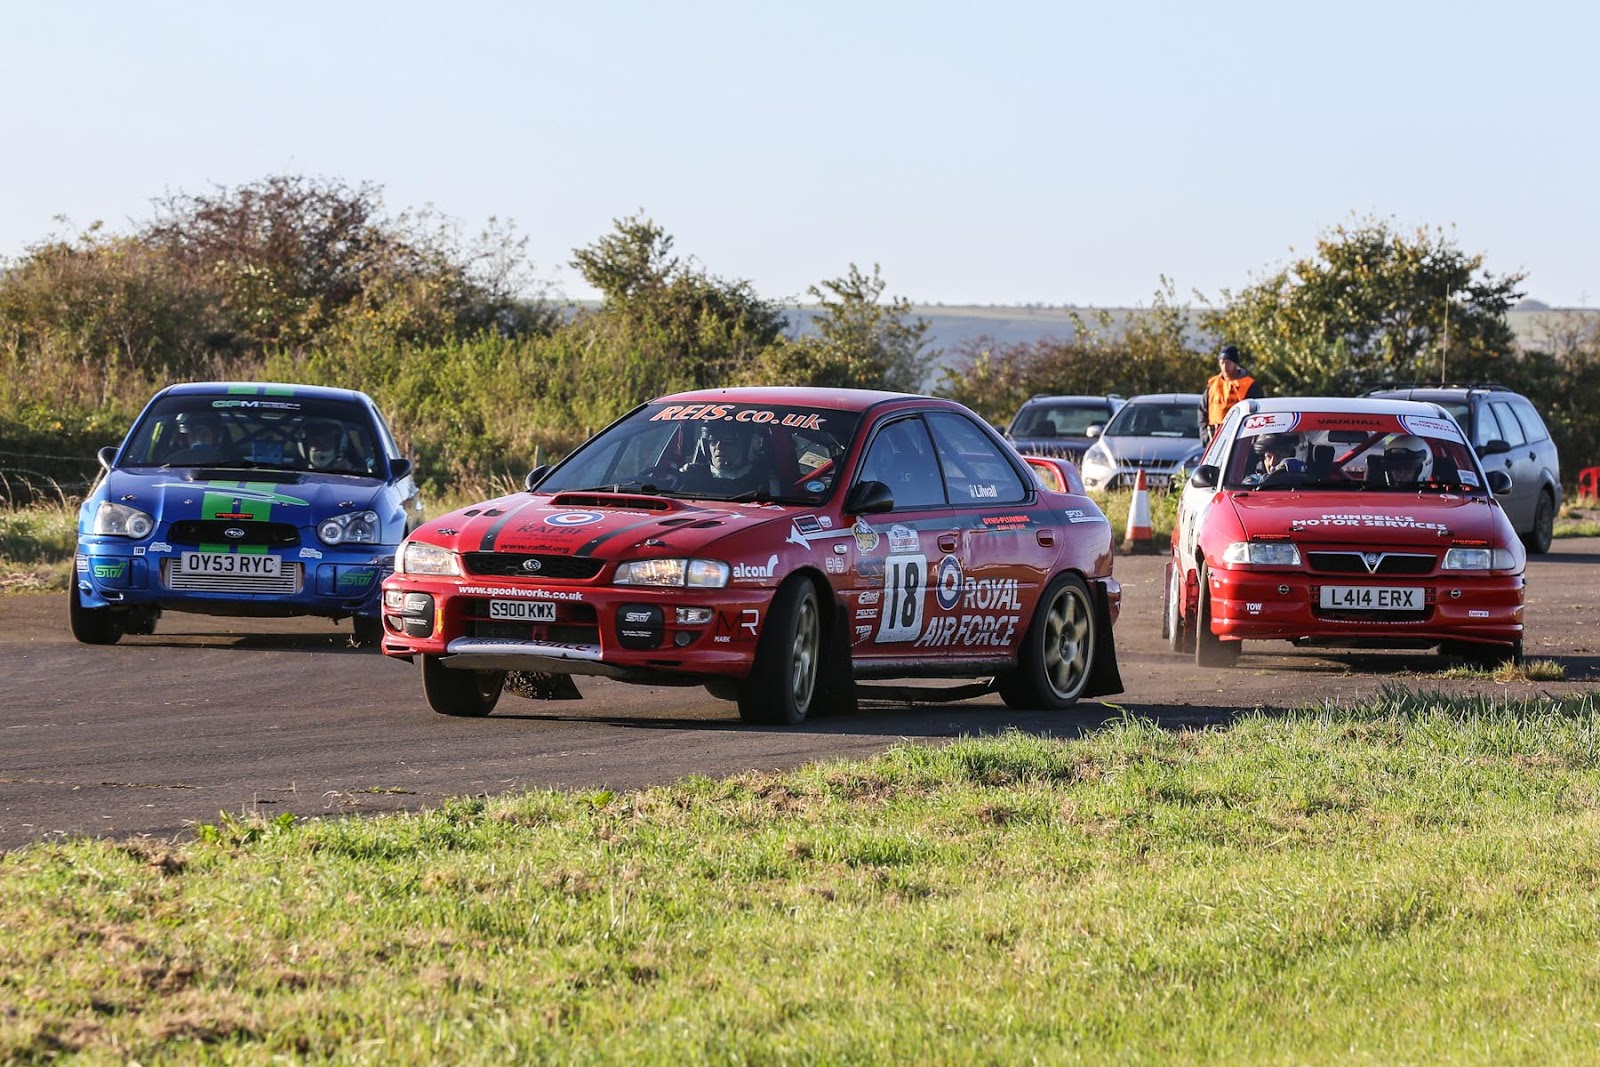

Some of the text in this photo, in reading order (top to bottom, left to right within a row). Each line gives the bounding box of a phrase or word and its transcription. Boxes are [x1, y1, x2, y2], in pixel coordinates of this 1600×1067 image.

[650, 404, 827, 431] REIS.co.uk
[1292, 519, 1448, 530] MOTOR SERVICES
[1321, 514, 1415, 522] MUNDELL'S
[189, 554, 273, 573] OY53 RYC
[733, 563, 767, 578] alcon
[458, 586, 583, 600] www.spookworks.co.uk
[889, 562, 919, 629] 18
[963, 576, 1022, 611] ROYAL
[1331, 589, 1413, 607] L414 ERX
[491, 602, 554, 618] S900 KWX
[1246, 603, 1262, 611] TOW
[913, 615, 1019, 648] AIR FORCE
